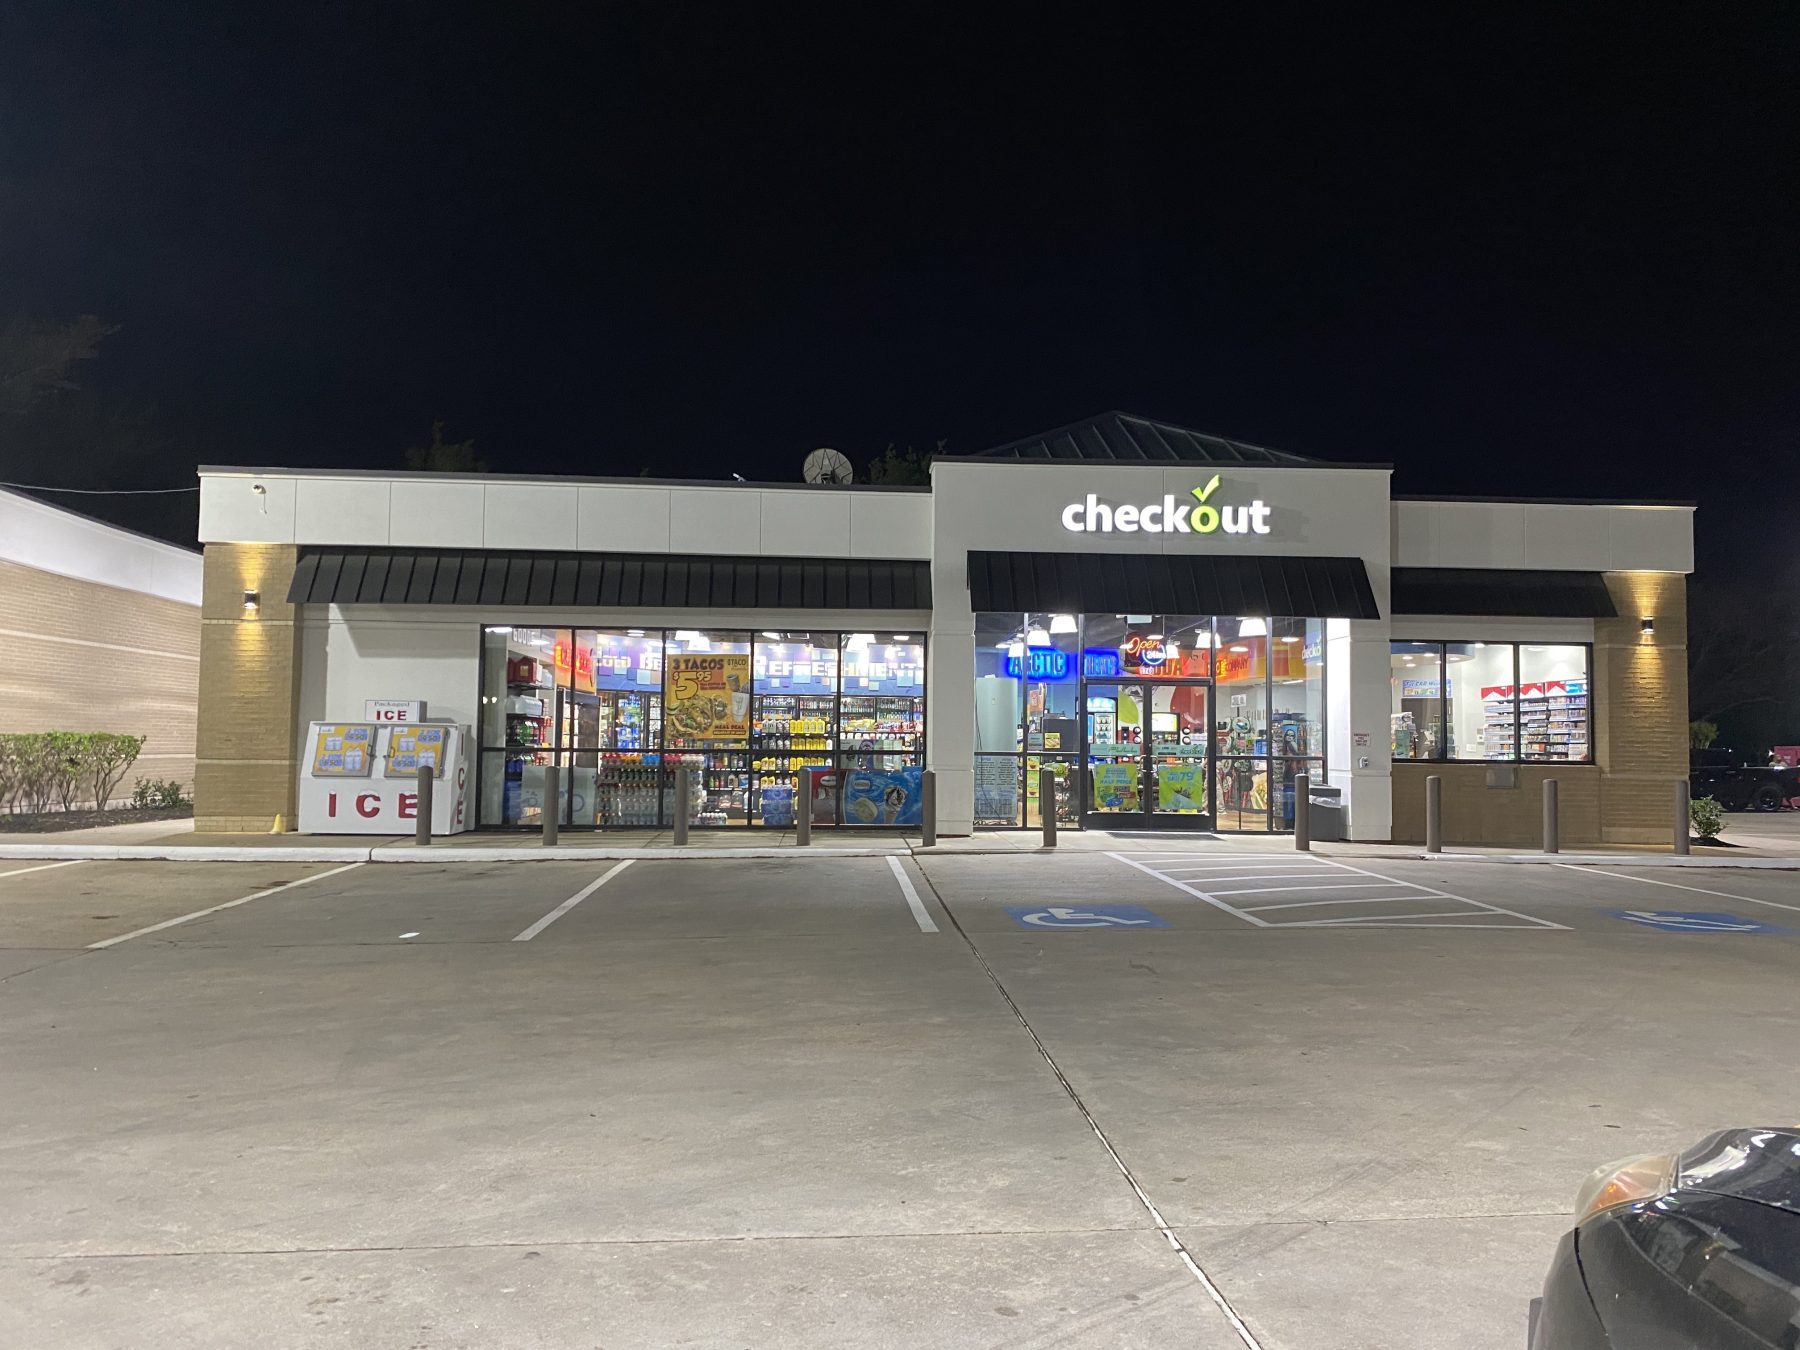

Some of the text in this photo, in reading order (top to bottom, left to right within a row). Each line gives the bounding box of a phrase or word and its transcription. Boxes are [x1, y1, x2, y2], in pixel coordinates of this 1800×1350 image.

[1061, 493, 1271, 535] checkout
[1127, 637, 1161, 657] Open
[673, 659, 680, 670] 3
[683, 659, 724, 670] TACOS
[376, 710, 407, 720] ICE
[328, 792, 418, 818] ICE
